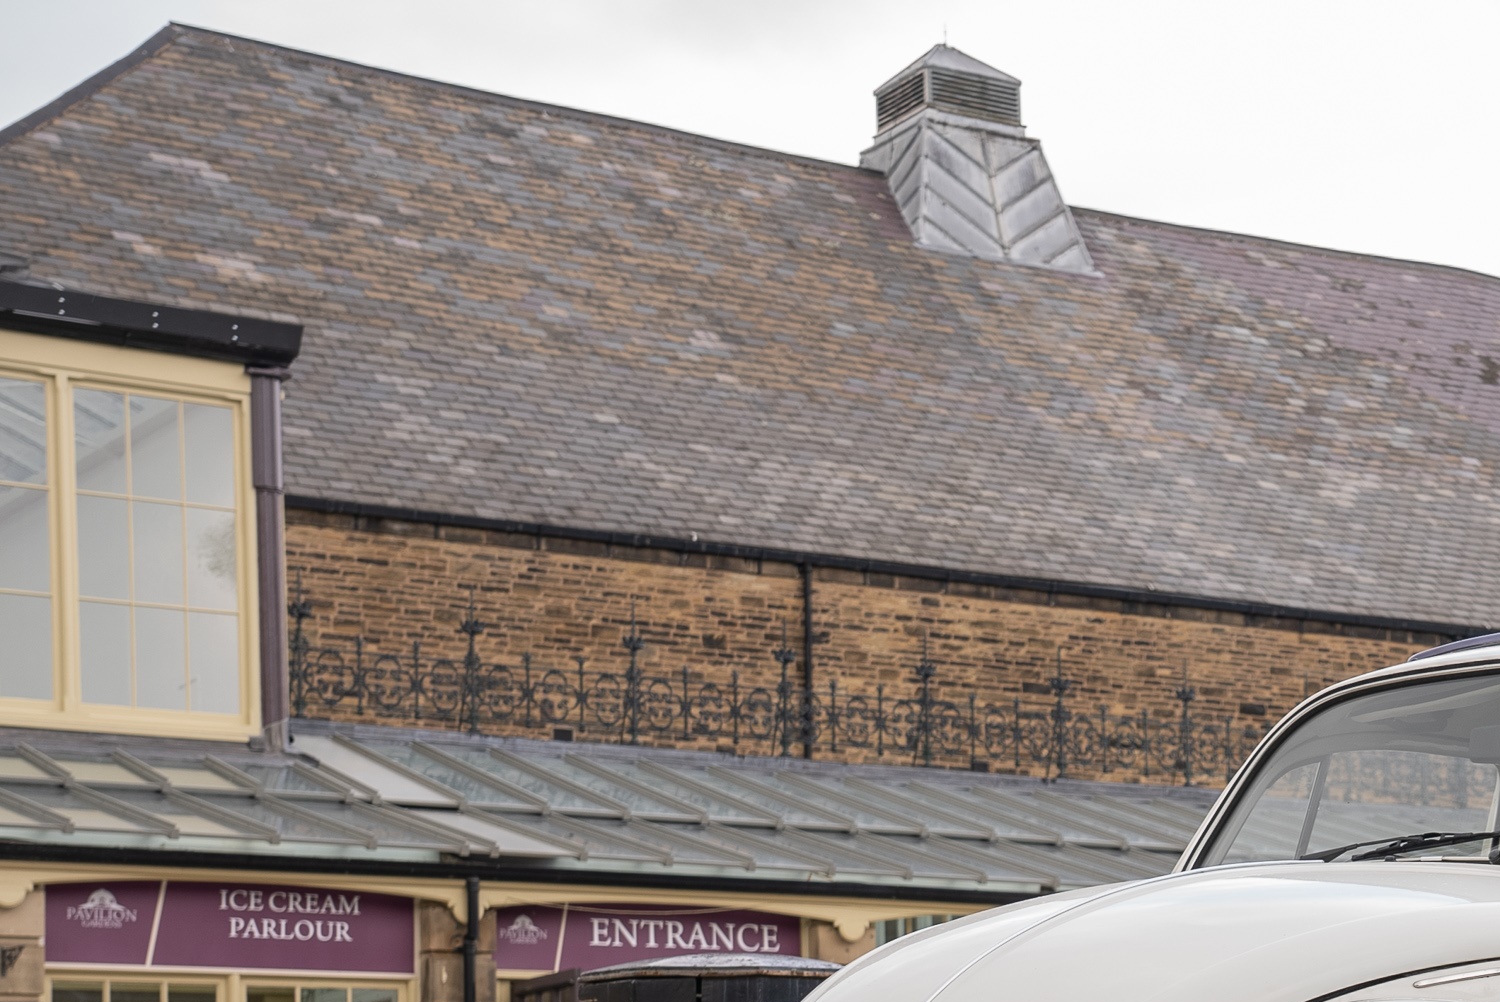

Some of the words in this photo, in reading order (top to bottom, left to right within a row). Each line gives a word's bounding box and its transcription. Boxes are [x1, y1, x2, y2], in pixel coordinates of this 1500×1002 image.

[66, 906, 138, 923] PAVILION
[219, 889, 264, 912] ICE
[268, 890, 361, 917] CREAM
[228, 916, 353, 943] PARLOUR
[589, 916, 781, 952] ENTRANCE
